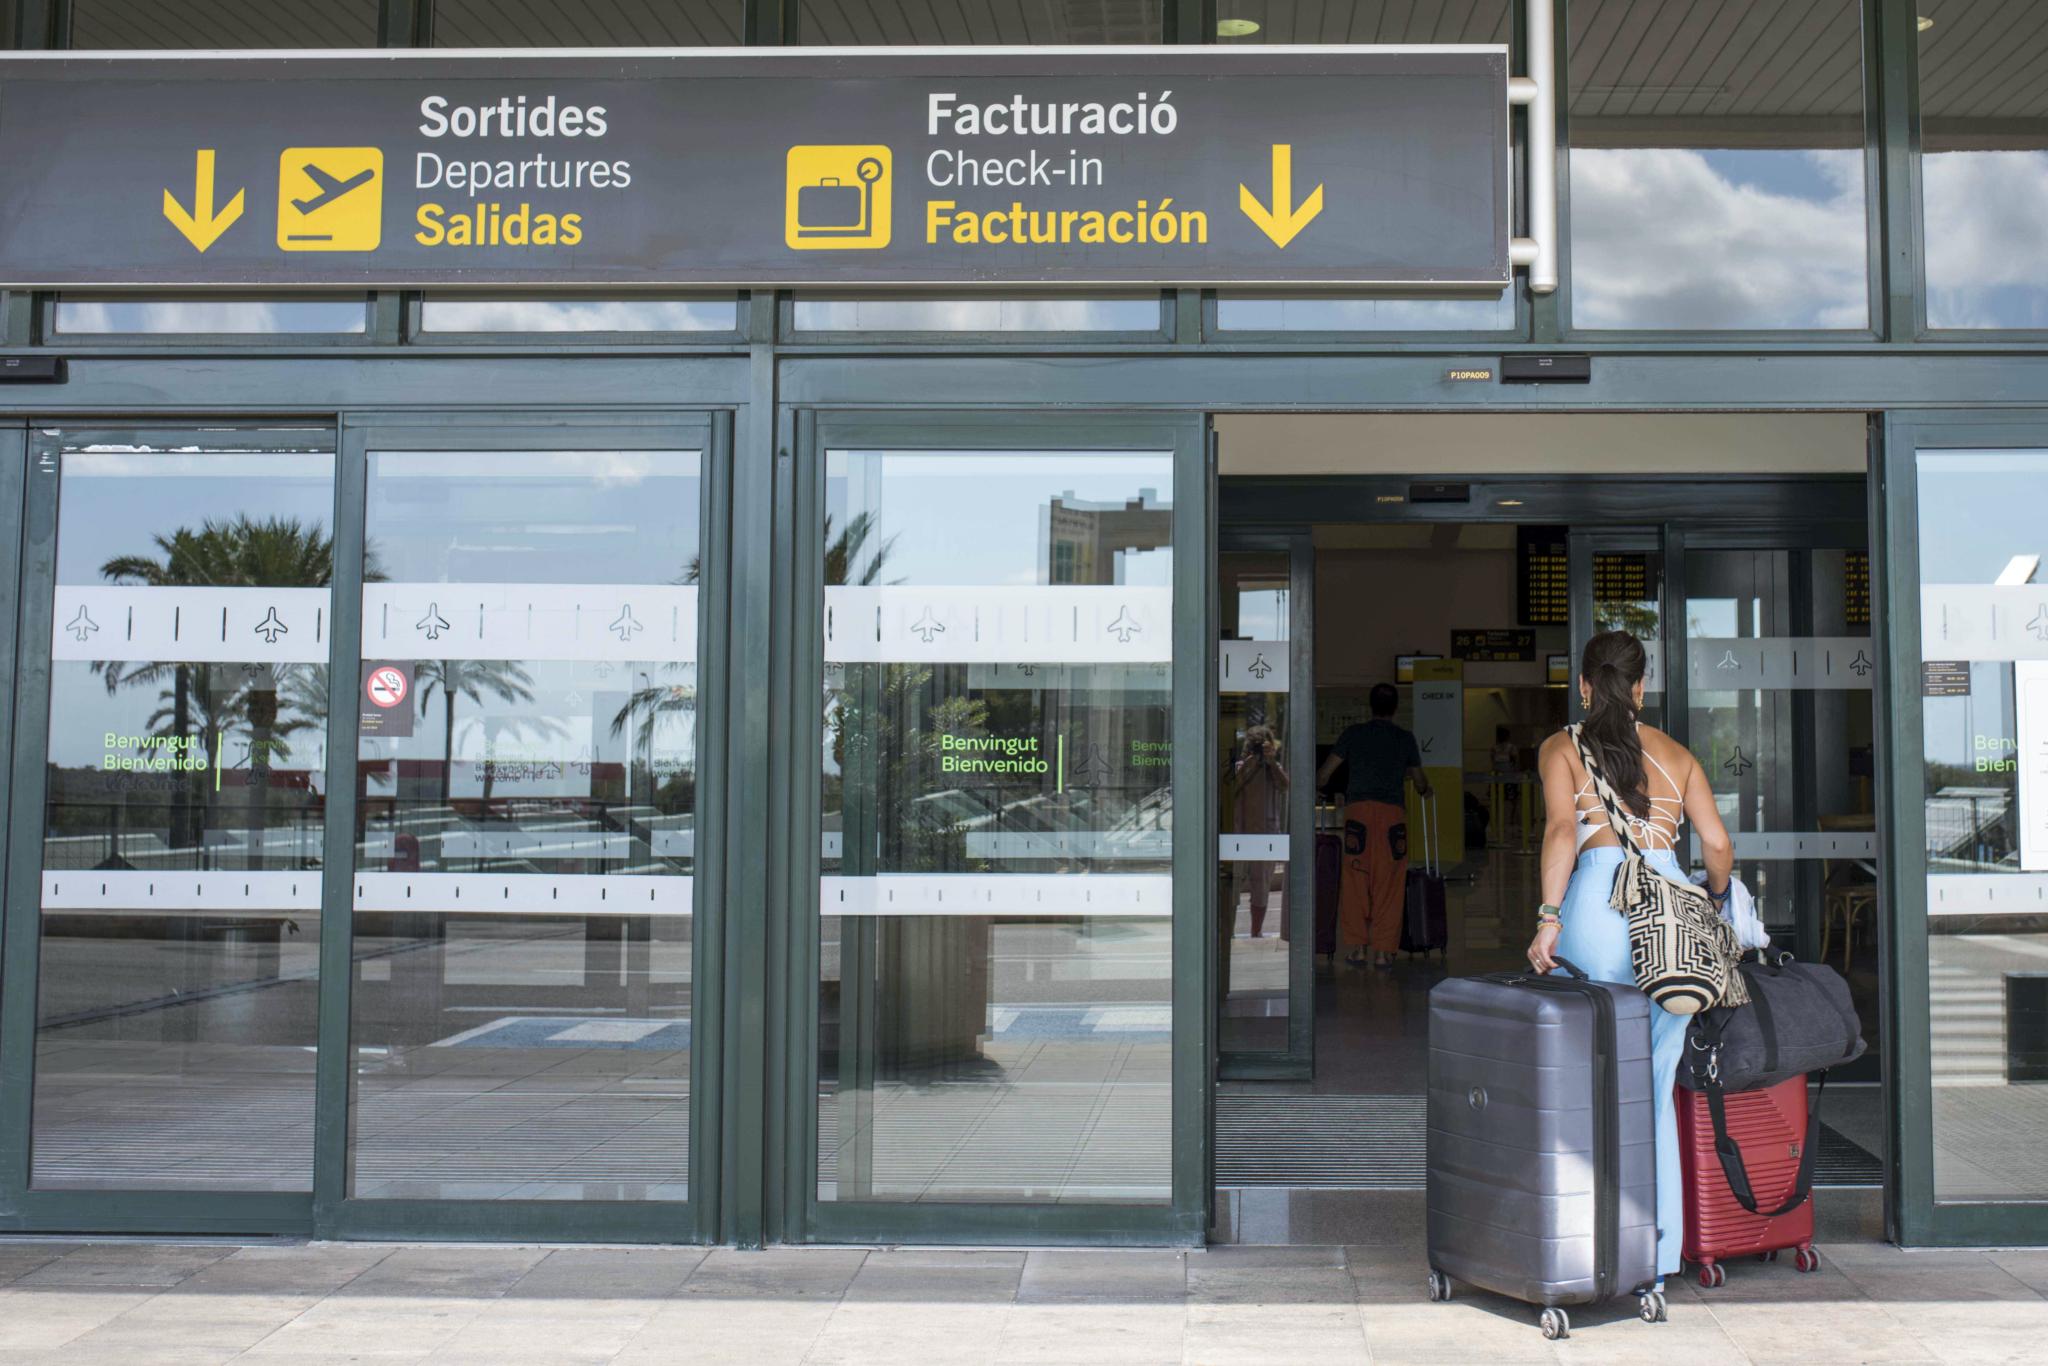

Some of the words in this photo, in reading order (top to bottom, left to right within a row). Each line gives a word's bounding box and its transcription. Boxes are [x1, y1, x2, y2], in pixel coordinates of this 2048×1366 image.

[418, 95, 608, 138] Sortides
[927, 90, 1179, 135] Facturació
[415, 152, 632, 197] Departures
[926, 148, 1104, 187] Check-in
[414, 203, 583, 247] Salidas
[925, 198, 1209, 244] Facturación
[1450, 371, 1490, 379] P10PA009
[1421, 692, 1444, 700] CHECK
[104, 732, 198, 753] Benvingut
[941, 734, 1039, 755] Benvingut
[103, 753, 208, 771] Bienvenido
[941, 756, 1049, 773] Bienvenido
